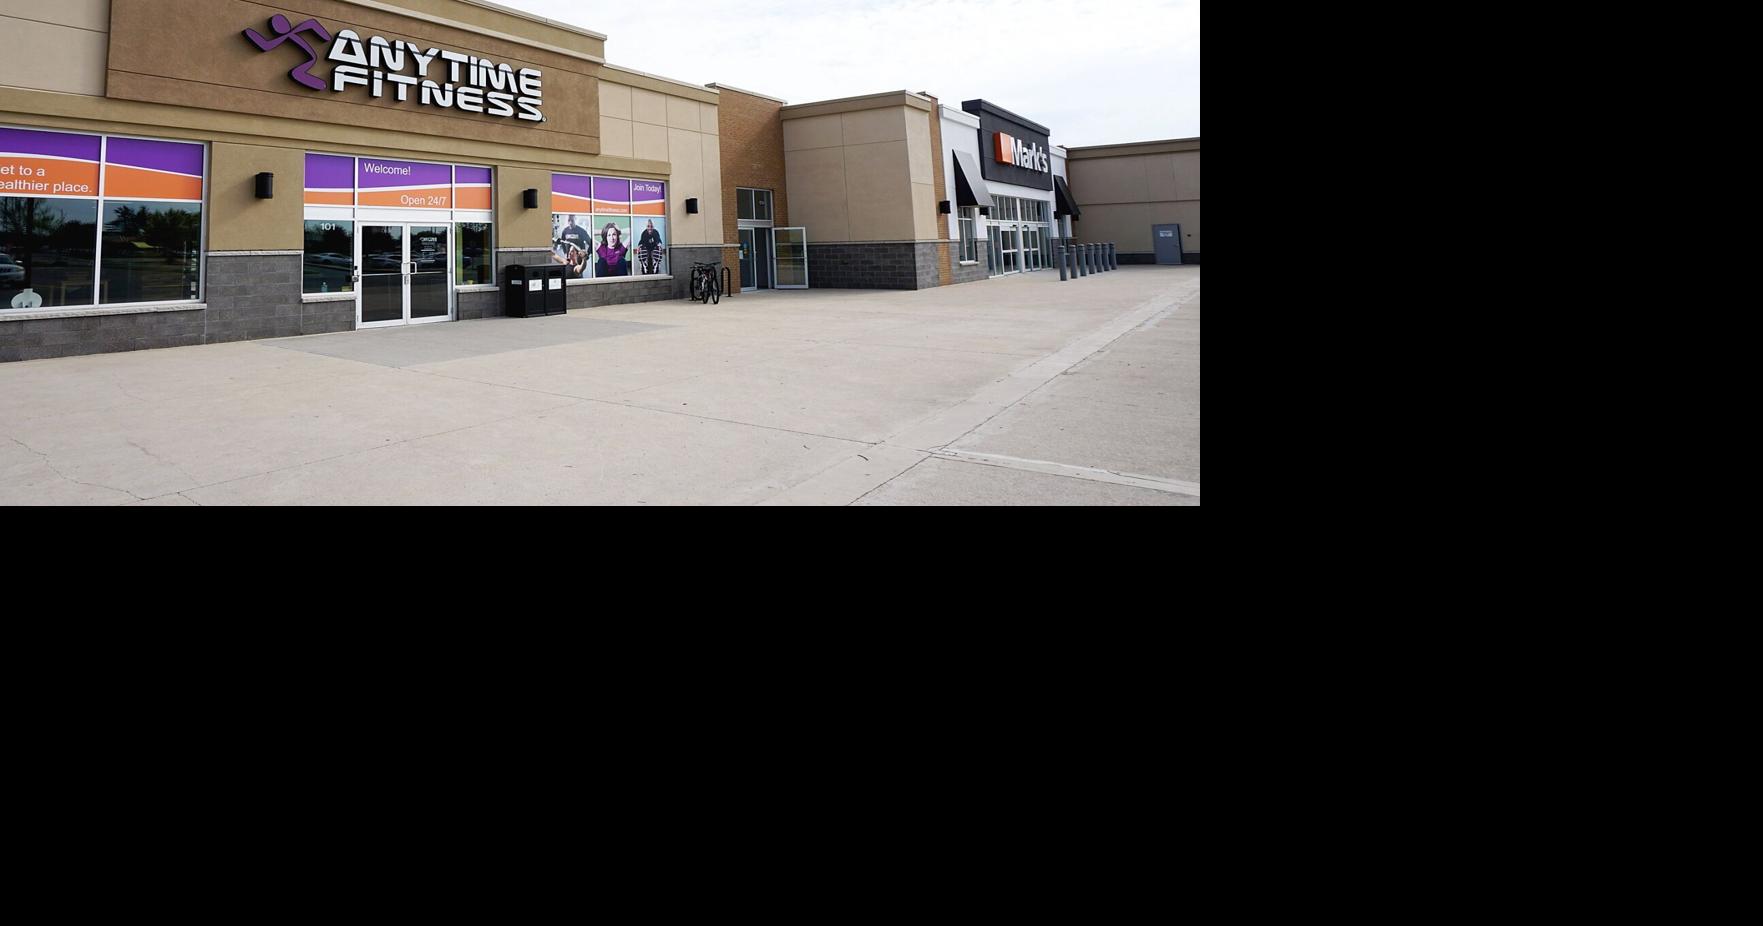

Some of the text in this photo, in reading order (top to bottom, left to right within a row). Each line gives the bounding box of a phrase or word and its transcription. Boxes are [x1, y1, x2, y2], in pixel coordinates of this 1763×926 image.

[328, 29, 542, 98] ANYTIME
[334, 64, 543, 122] FITNESS
[1010, 136, 1048, 173] Mark's
[19, 165, 32, 176] to
[36, 168, 45, 177] a
[364, 162, 411, 176] Welcome!
[53, 181, 92, 194] place.
[634, 184, 662, 194] Join Today!
[400, 194, 447, 207] Open 24/7
[320, 223, 336, 231] 101
